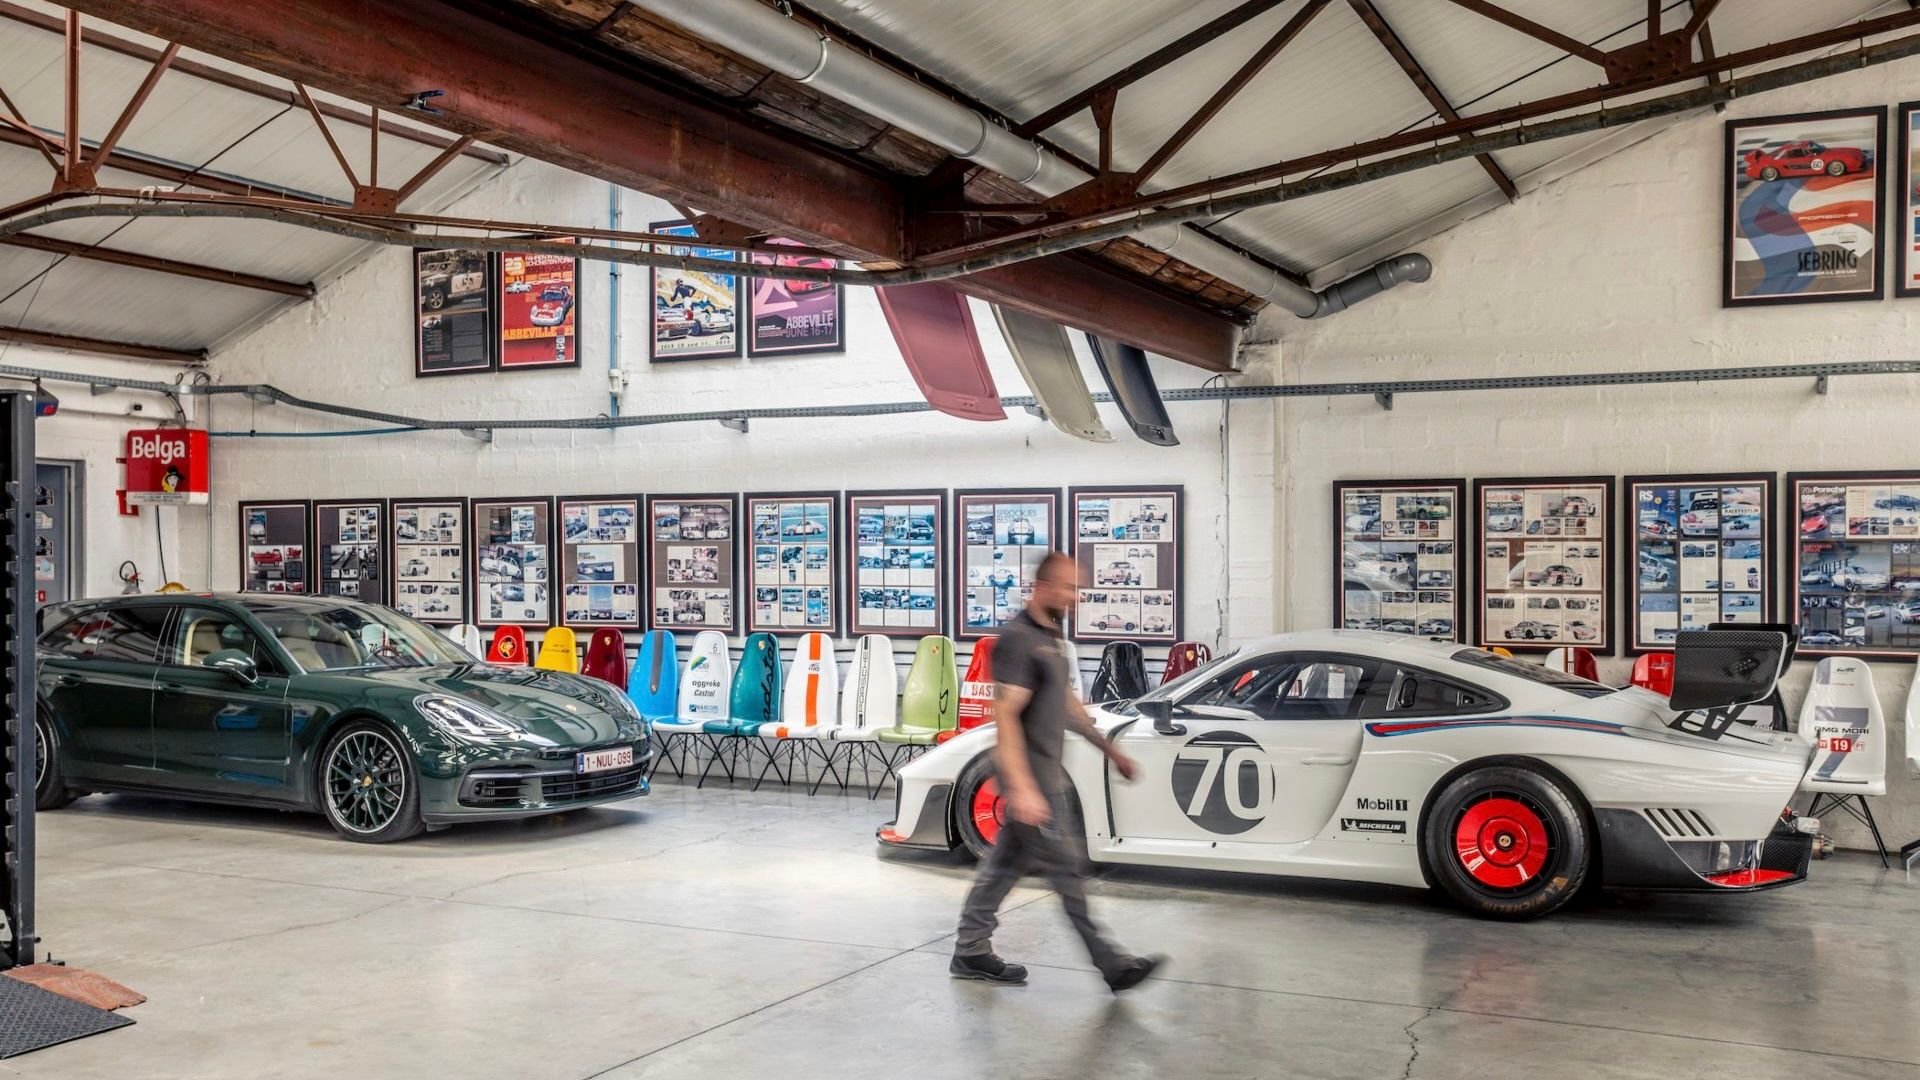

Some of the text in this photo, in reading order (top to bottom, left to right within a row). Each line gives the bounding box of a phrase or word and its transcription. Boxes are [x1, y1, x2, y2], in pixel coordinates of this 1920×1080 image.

[1798, 248, 1857, 272] SEBRING
[786, 312, 834, 329] ABBEVILLE
[504, 327, 558, 340] ABBEVILLE
[786, 327, 809, 338] JUNE
[811, 325, 833, 337] 16-17
[131, 434, 186, 465] Belga
[1639, 490, 1655, 502] RS
[692, 680, 721, 688] aggreko
[859, 651, 869, 713] PORSCHE
[1832, 739, 1849, 751] 19
[586, 751, 632, 769] 1-NUU-099
[1177, 747, 1273, 820] 70
[1357, 798, 1393, 811] Mobil
[1359, 822, 1402, 831] MICHELIN
